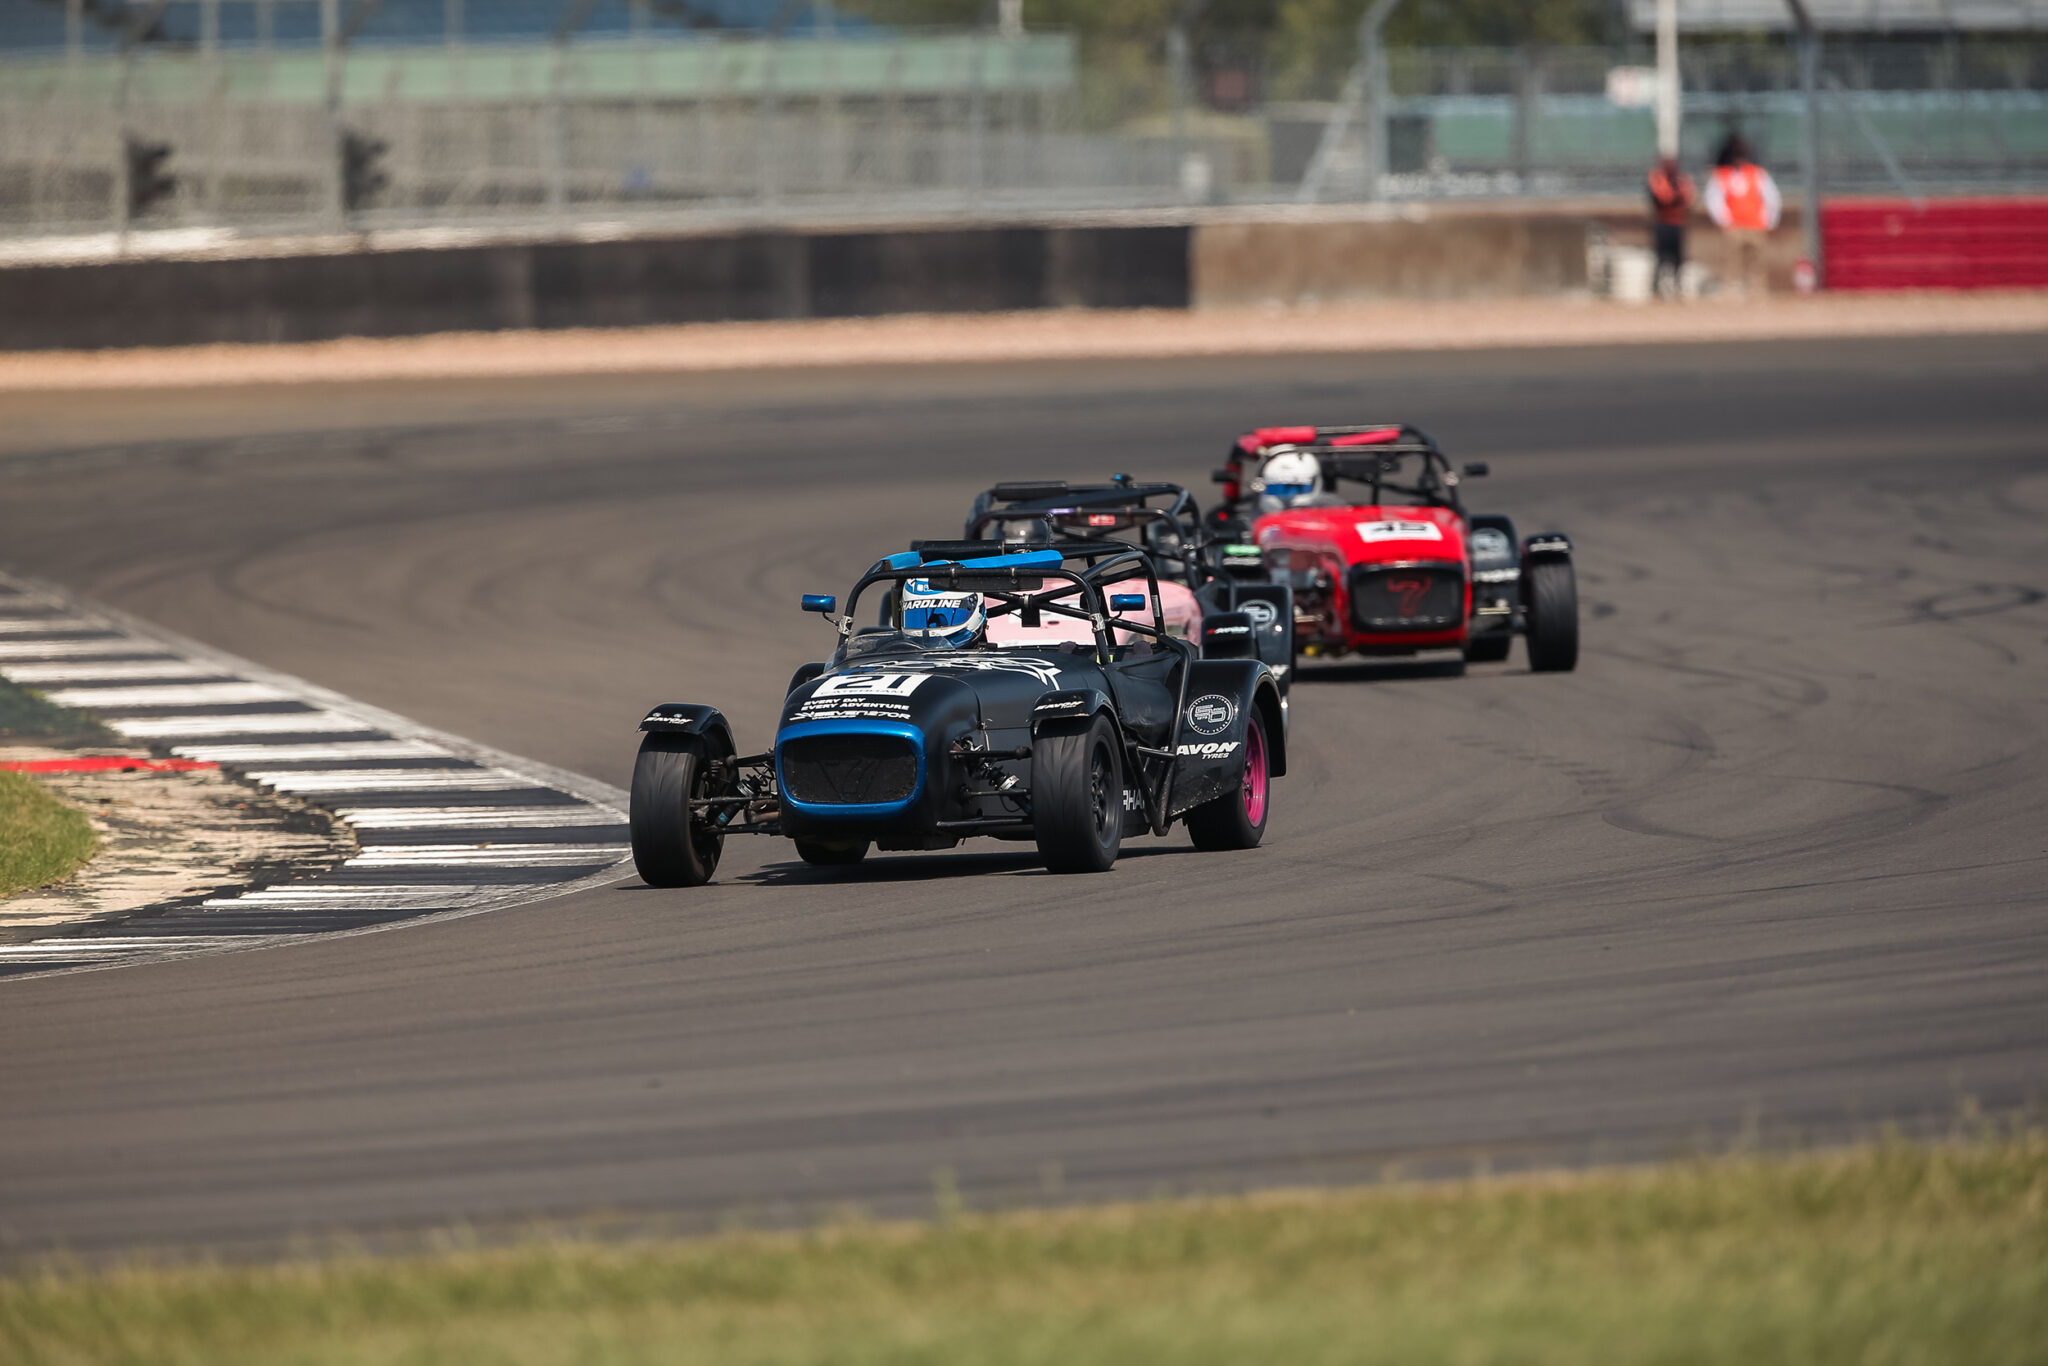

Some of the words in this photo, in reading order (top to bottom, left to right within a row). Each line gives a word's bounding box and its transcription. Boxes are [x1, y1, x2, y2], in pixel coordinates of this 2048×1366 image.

[833, 675, 913, 690] 21
[800, 703, 839, 711] EVERY
[839, 702, 910, 710] ADVENTURE
[804, 698, 841, 706] EVERY
[1176, 741, 1241, 756] AVON
[1201, 752, 1230, 760] TYRES
